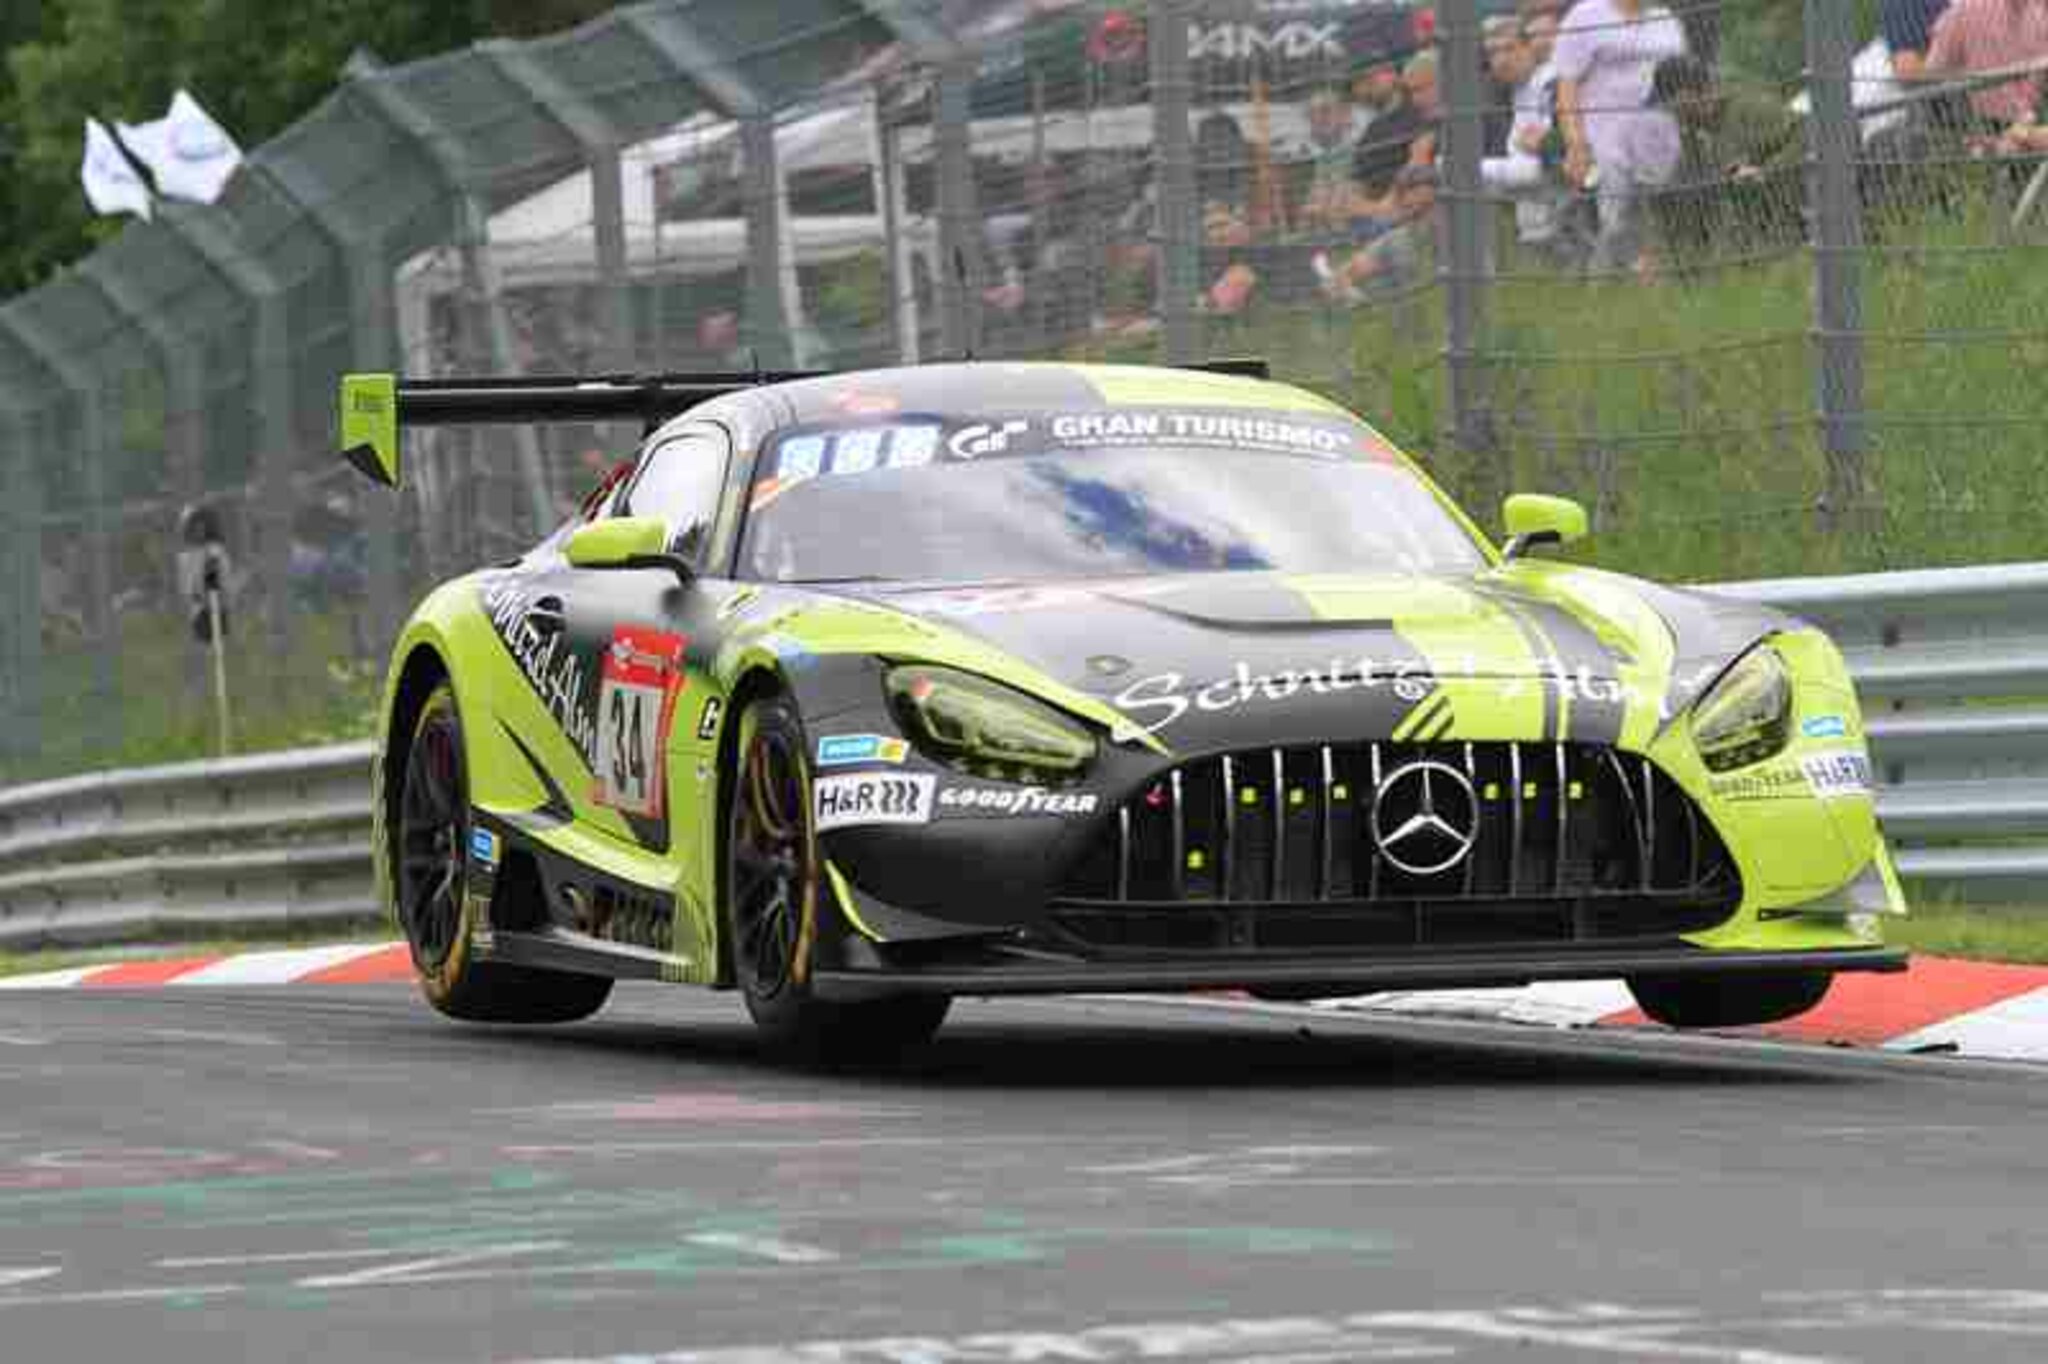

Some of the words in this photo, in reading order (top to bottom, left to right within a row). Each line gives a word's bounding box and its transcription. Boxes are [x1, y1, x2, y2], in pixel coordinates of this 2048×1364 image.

[1053, 413, 1157, 438] GRAN
[612, 690, 648, 800] 34
[818, 781, 875, 817] H&R
[940, 785, 1098, 814] GOODYEAR
